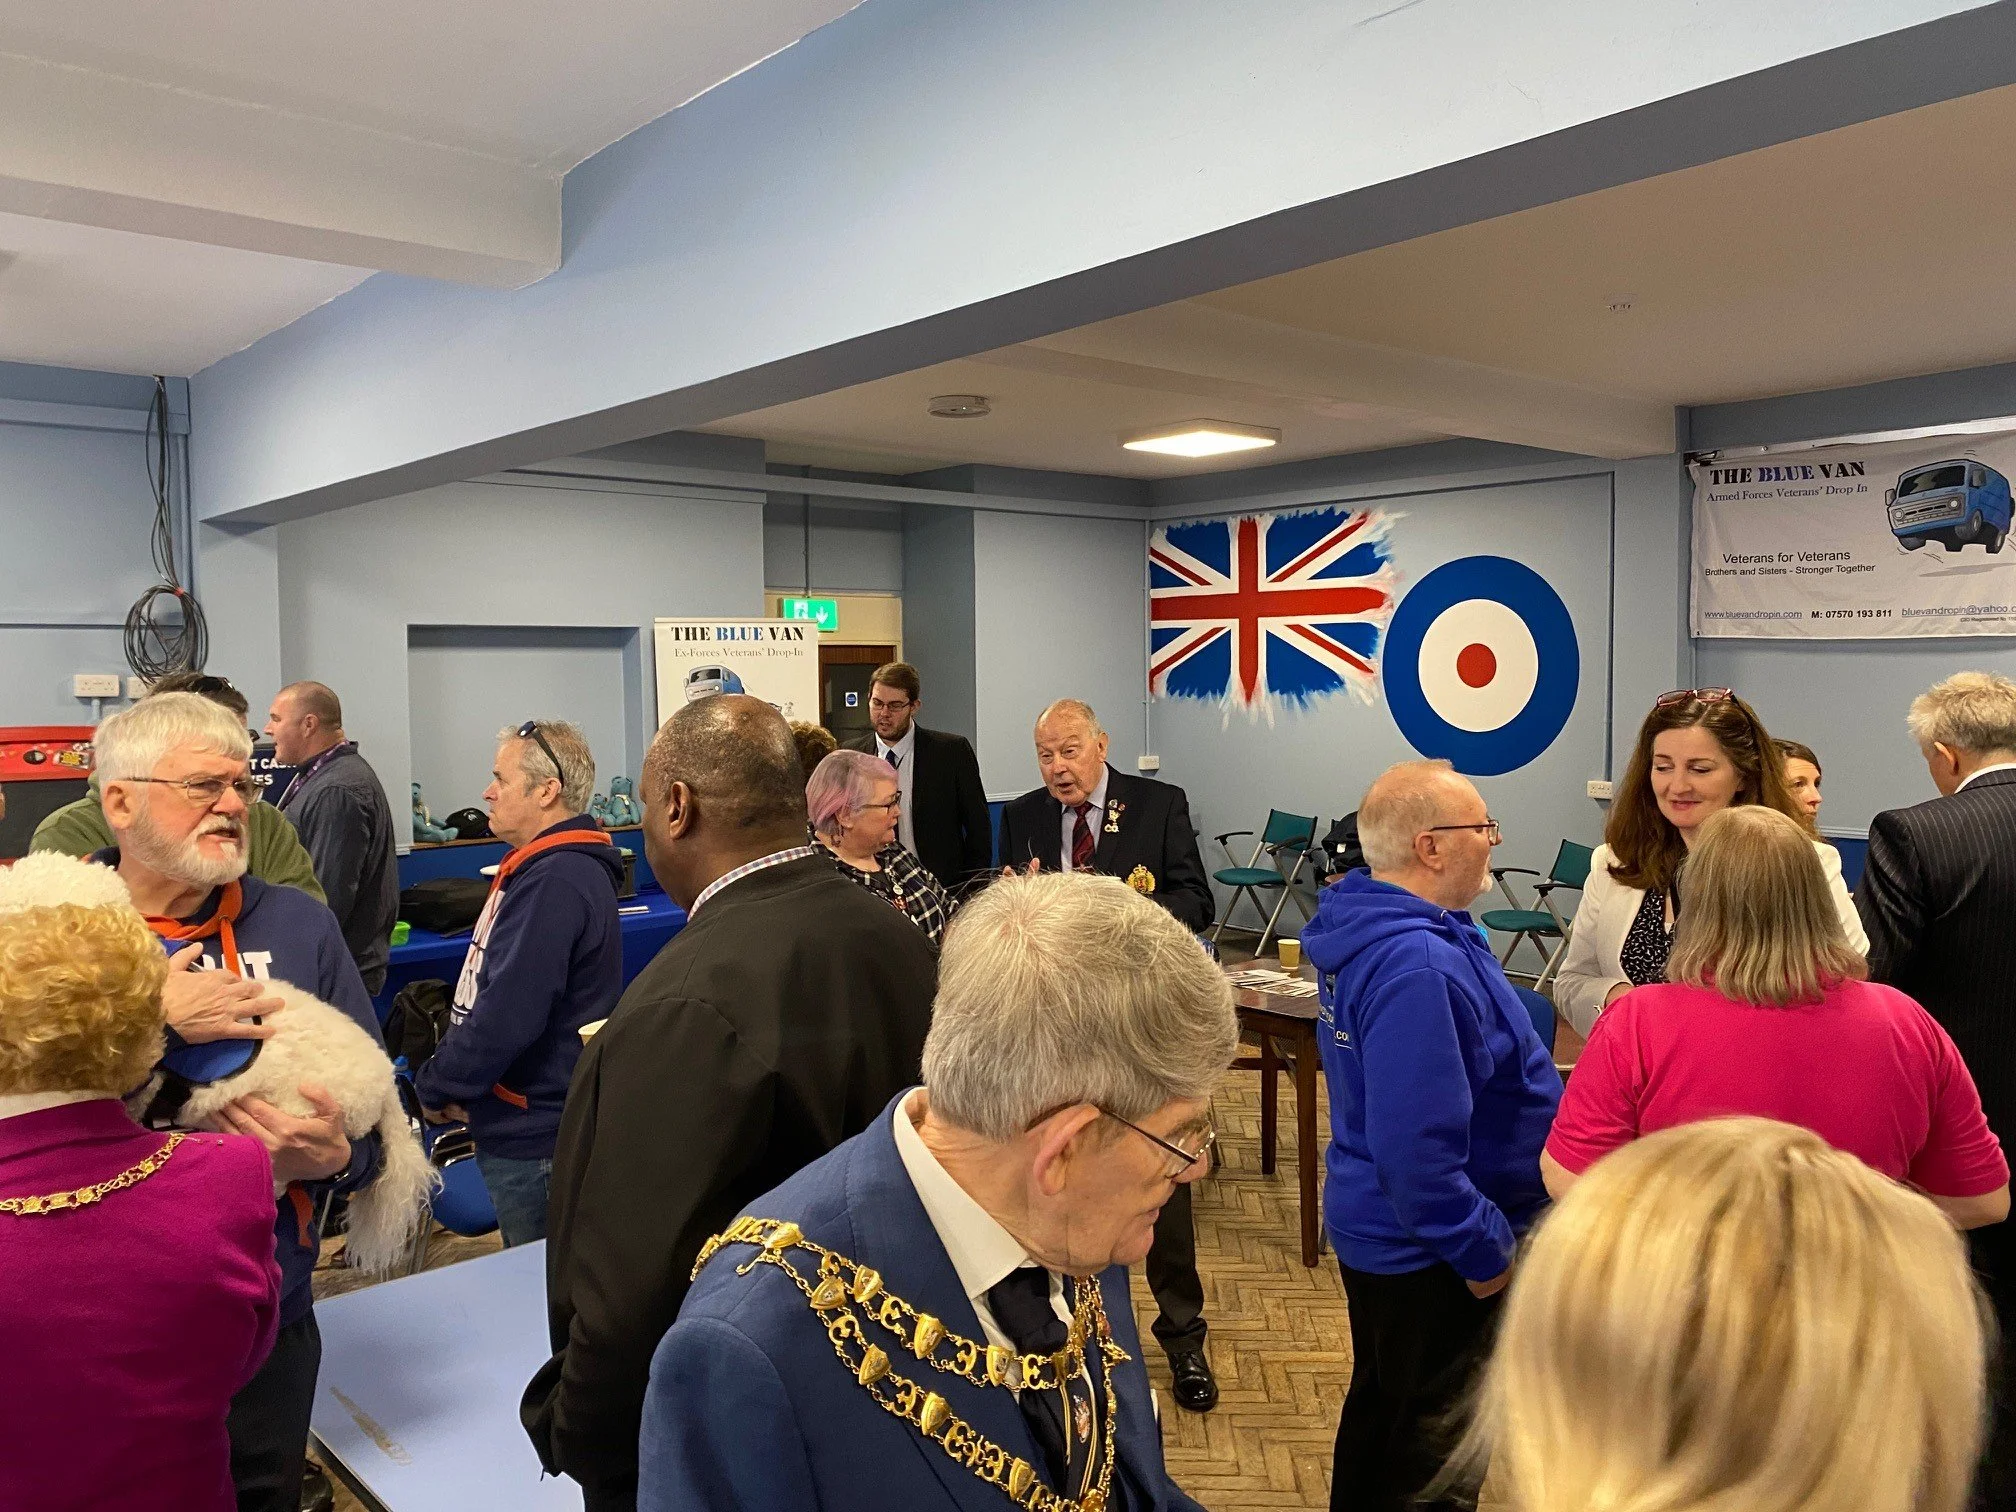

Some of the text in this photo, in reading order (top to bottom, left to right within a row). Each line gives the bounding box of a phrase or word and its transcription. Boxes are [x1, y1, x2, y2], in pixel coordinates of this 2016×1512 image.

[1709, 461, 1865, 485] THE BLUE VAN
[1706, 490, 1740, 502] Armed
[1743, 490, 1773, 500] Forces
[1825, 485, 1853, 496] Drop
[1856, 483, 1868, 493] In
[1722, 551, 1851, 564] Veterans for Veterans
[1705, 568, 1738, 576] Brothers
[1739, 567, 1756, 576] and
[1758, 567, 1787, 575] Sisters
[1795, 566, 1834, 576] Stronger
[1836, 564, 1876, 575] Together
[1704, 610, 1802, 619] www.bluevandropin.com
[1811, 610, 1823, 619] M:
[1825, 610, 1854, 618] 07570
[1856, 609, 1873, 618] 193
[1876, 609, 1892, 618] 811
[671, 626, 804, 641] THE BLUE VAN
[674, 648, 720, 657] Ex-Forces
[767, 647, 804, 658] Drop-In
